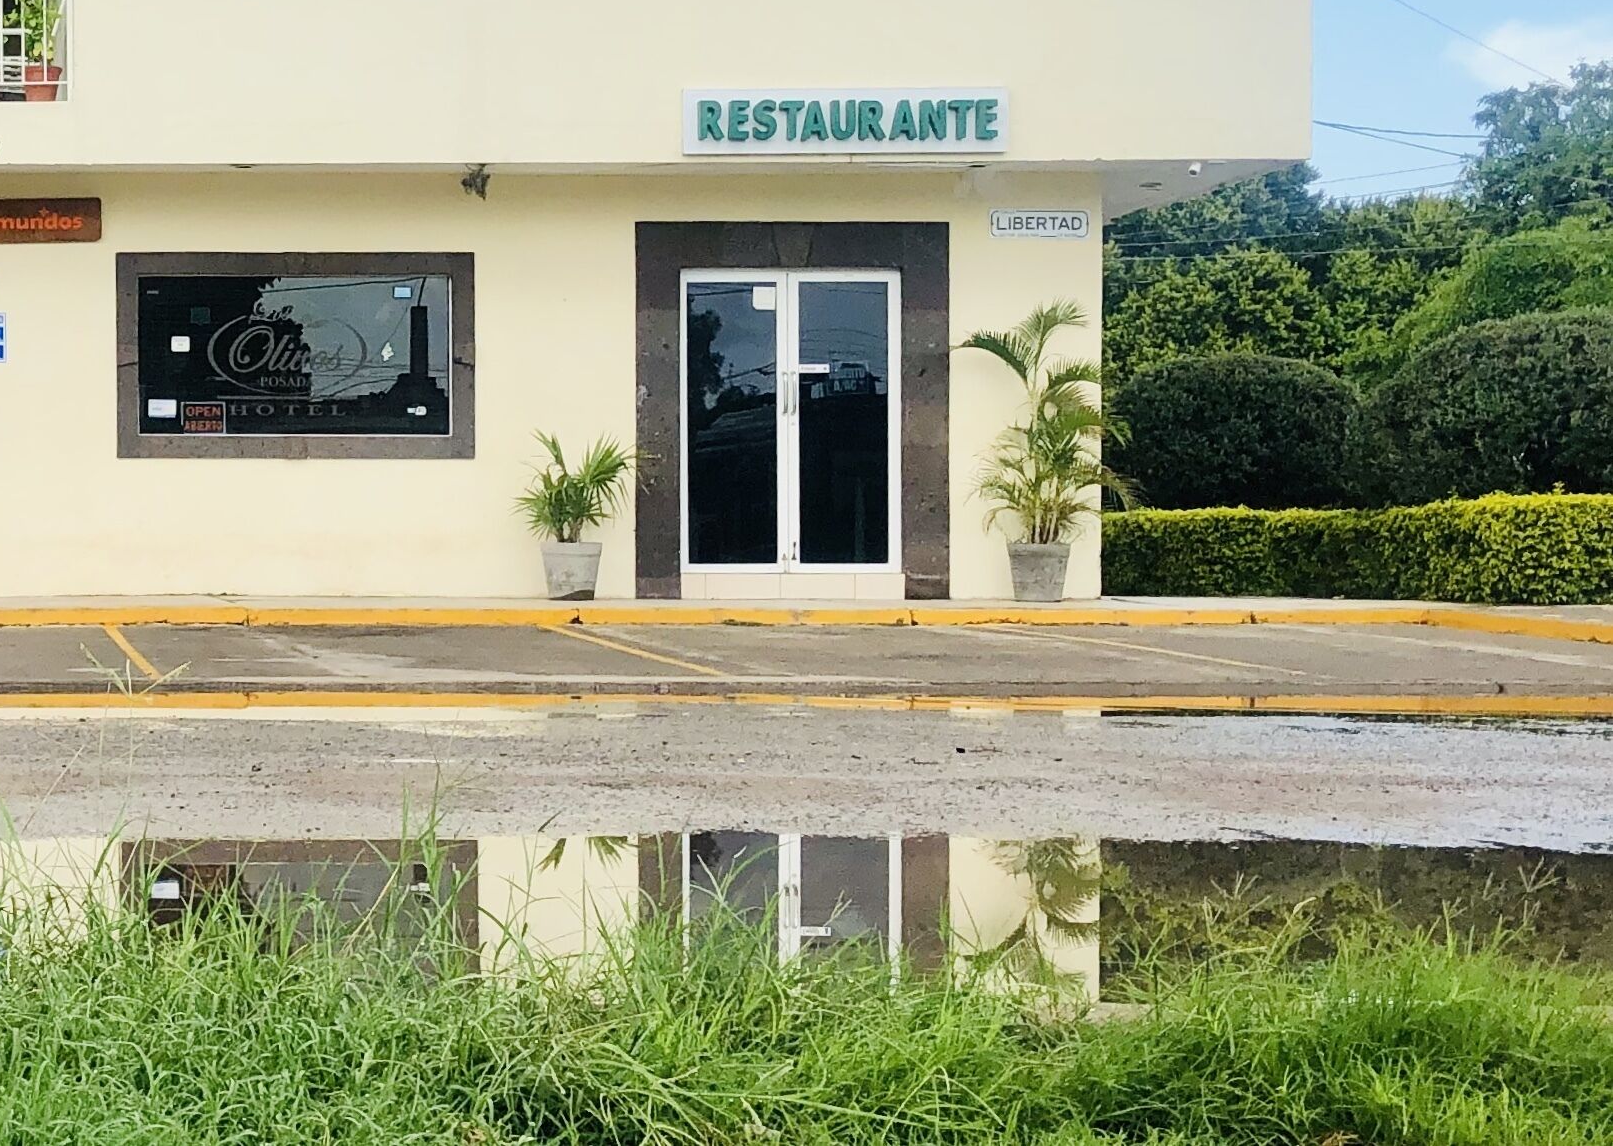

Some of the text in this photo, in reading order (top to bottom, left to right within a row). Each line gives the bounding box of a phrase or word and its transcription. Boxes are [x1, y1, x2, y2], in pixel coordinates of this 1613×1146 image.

[697, 98, 999, 141] RESTAURANTE
[996, 216, 1083, 230] LIBERTAD
[185, 406, 221, 416] OPEN
[229, 404, 347, 416] HOTEL
[183, 421, 223, 431] ABIERTO
